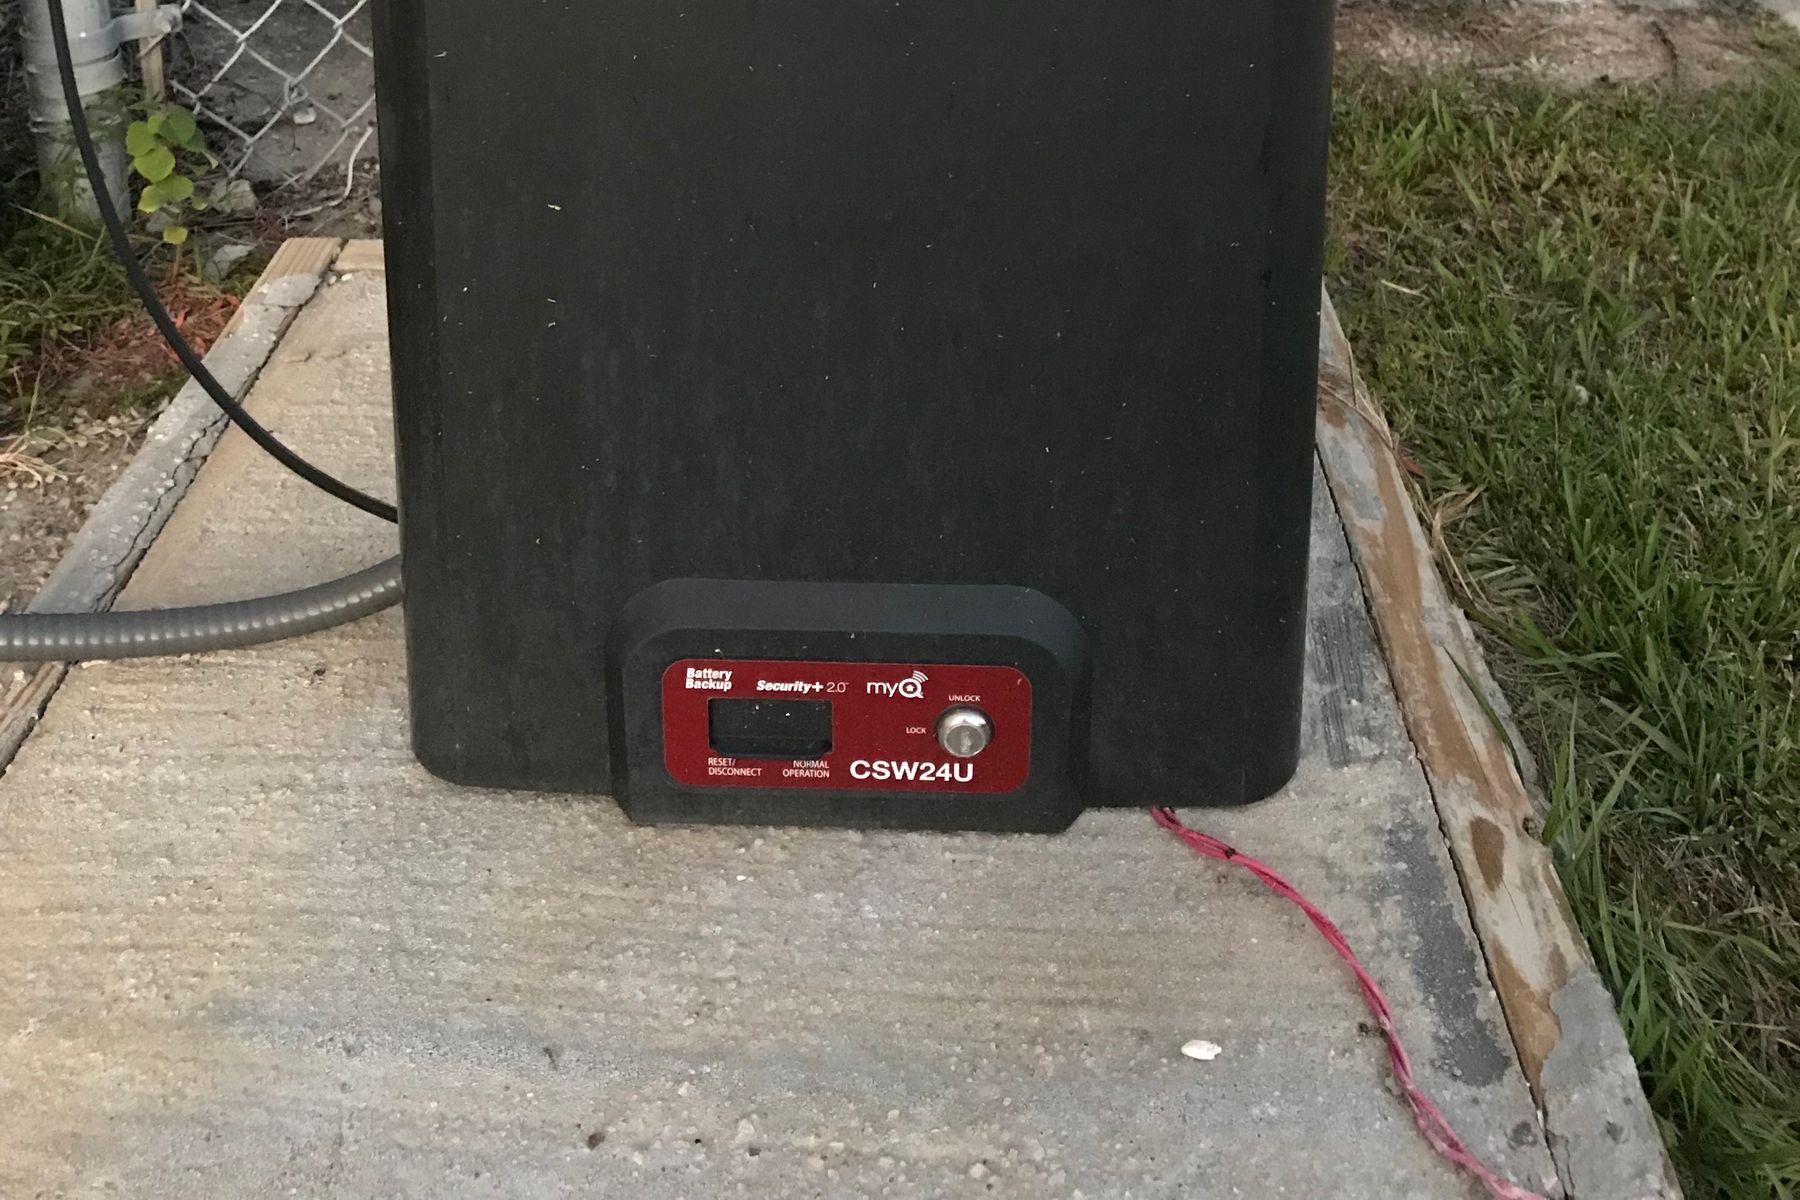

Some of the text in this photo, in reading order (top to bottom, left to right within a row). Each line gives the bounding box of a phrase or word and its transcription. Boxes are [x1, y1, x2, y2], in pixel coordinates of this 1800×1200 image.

[686, 668, 732, 682] Battery
[685, 678, 732, 692] Backup
[757, 680, 823, 694] Security+
[948, 694, 981, 702] UNLOCK
[906, 727, 926, 735] LOCK
[708, 757, 736, 767] RESET/
[793, 760, 830, 769] NORMAL
[708, 767, 762, 777] DISCONNECT
[782, 769, 830, 778] OPERATION
[850, 760, 974, 782] CSW24U
